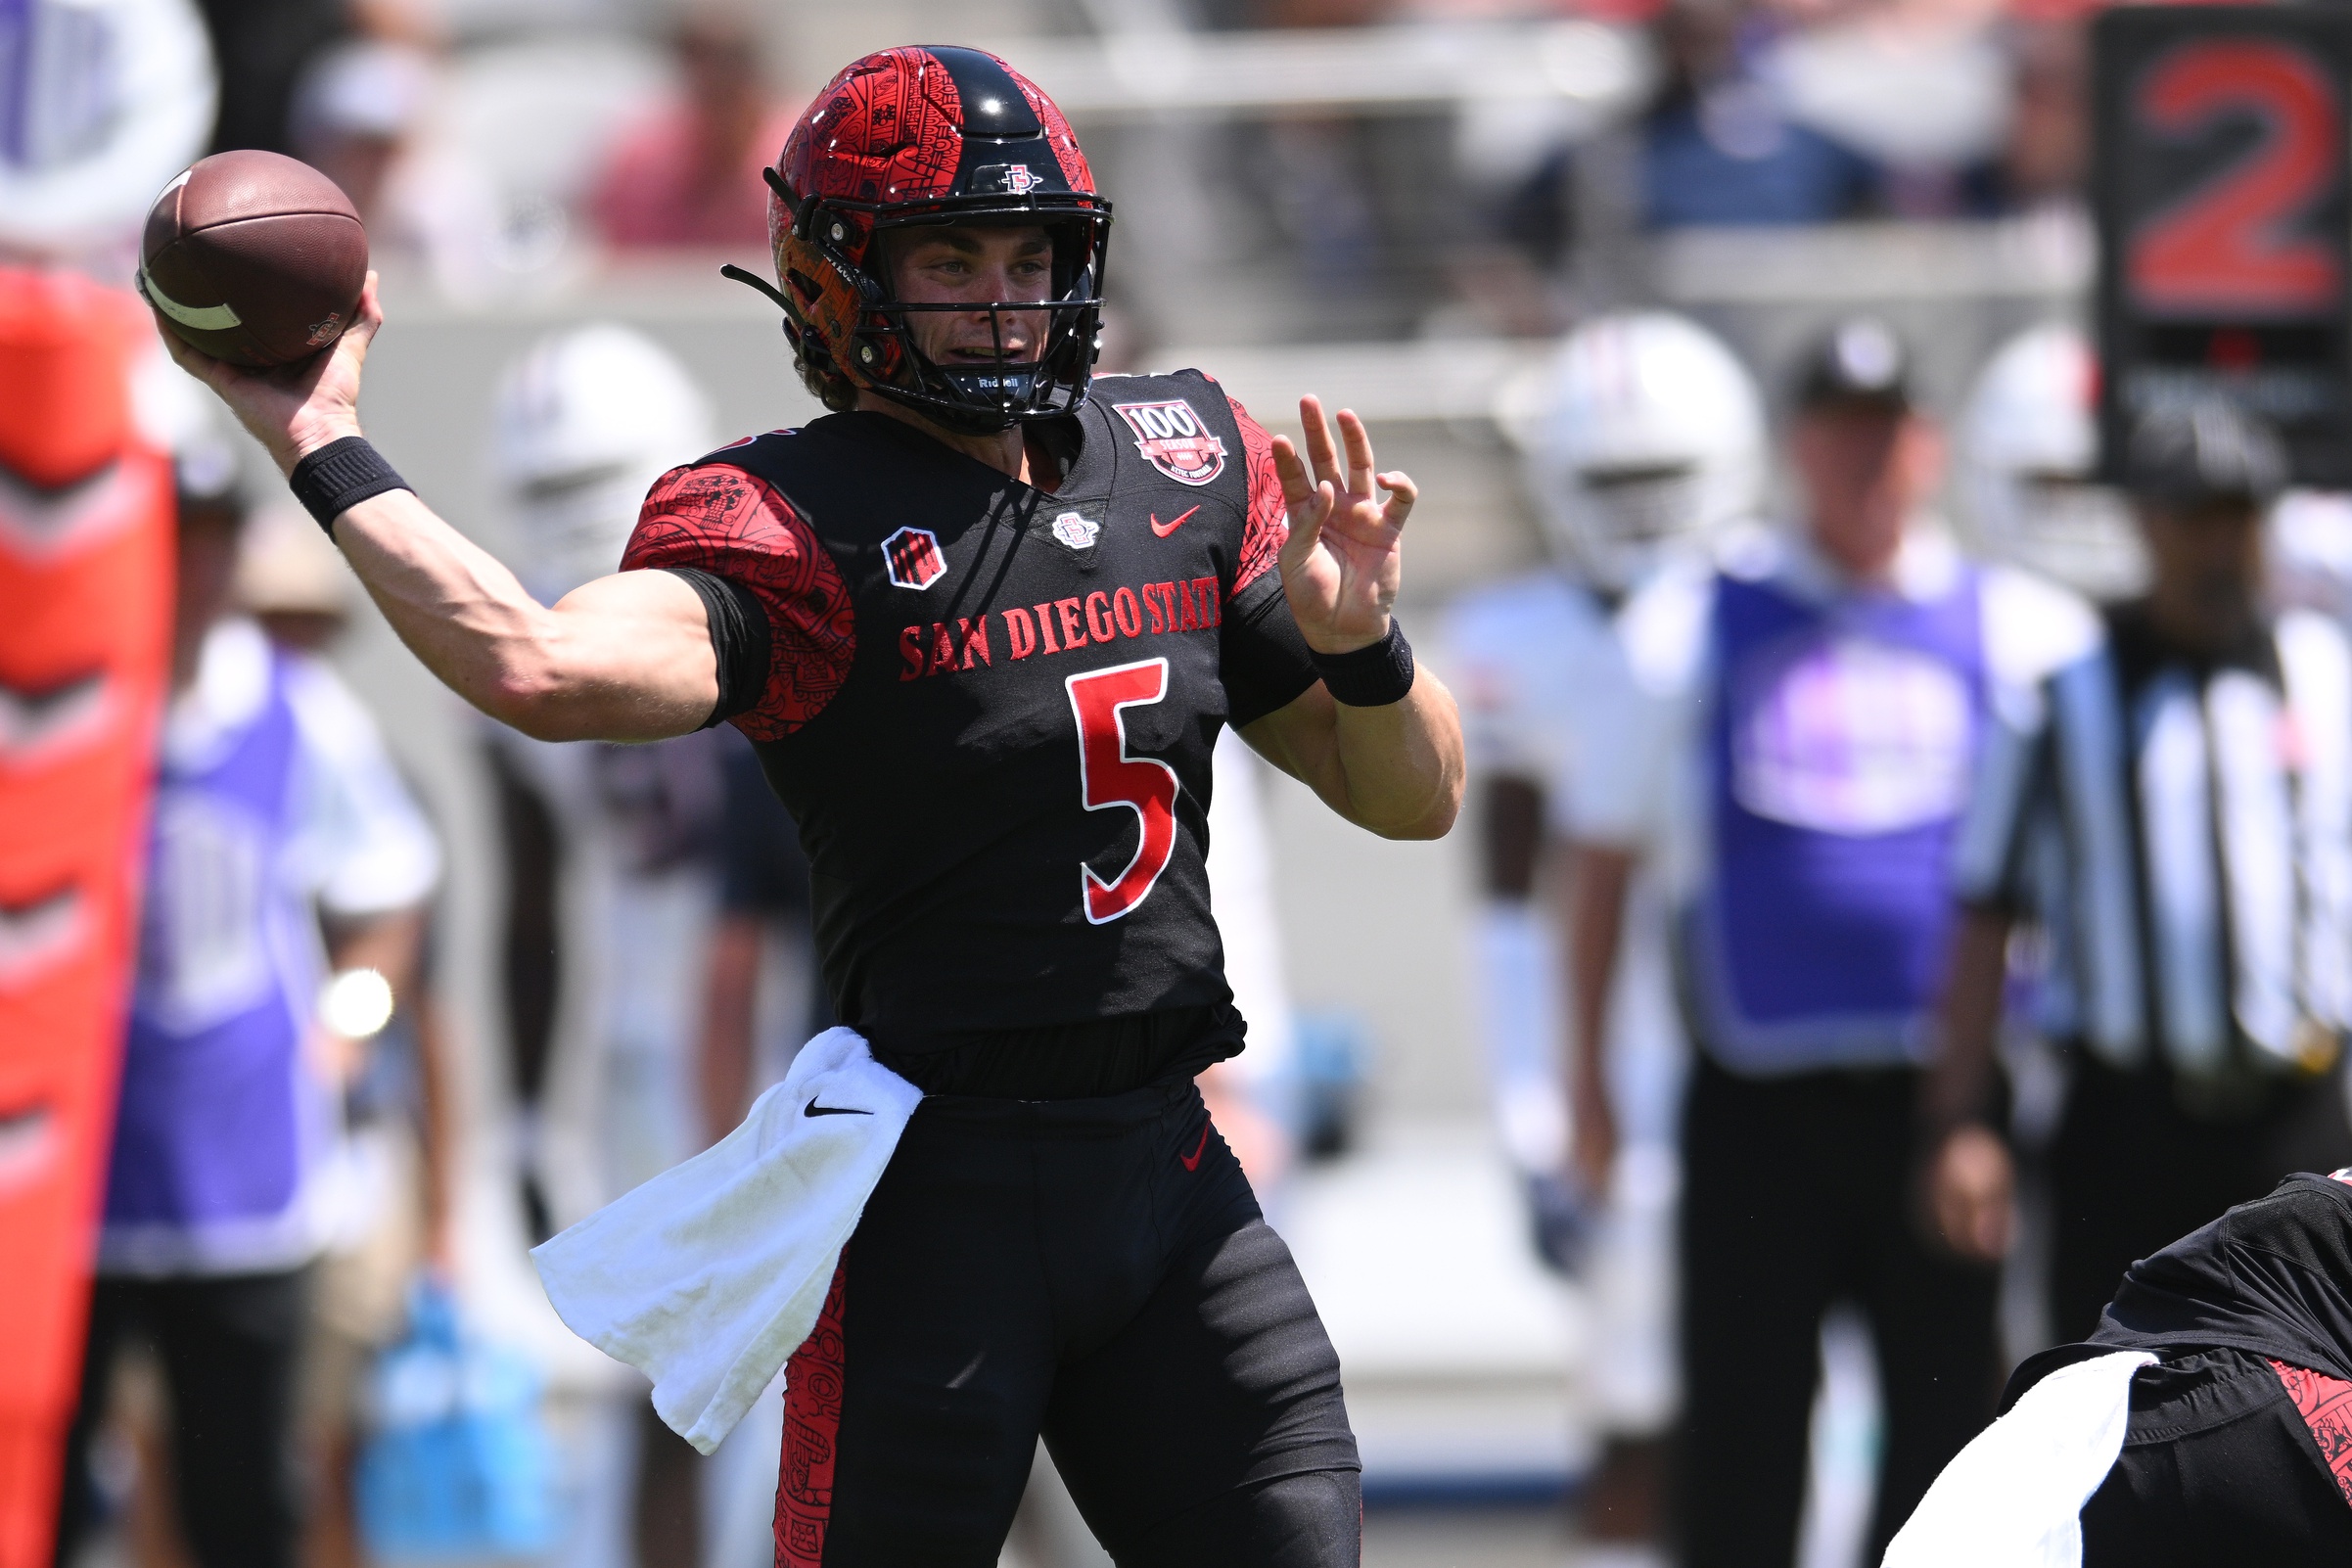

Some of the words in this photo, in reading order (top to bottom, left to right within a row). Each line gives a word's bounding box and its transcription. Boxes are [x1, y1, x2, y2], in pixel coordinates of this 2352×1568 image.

[2128, 37, 2341, 311] 2
[979, 378, 1019, 388] Ridell
[1159, 438, 1197, 450] SEASON
[899, 615, 992, 681] SAN
[1001, 587, 1141, 661] DIEGO
[1065, 657, 1179, 925] 5
